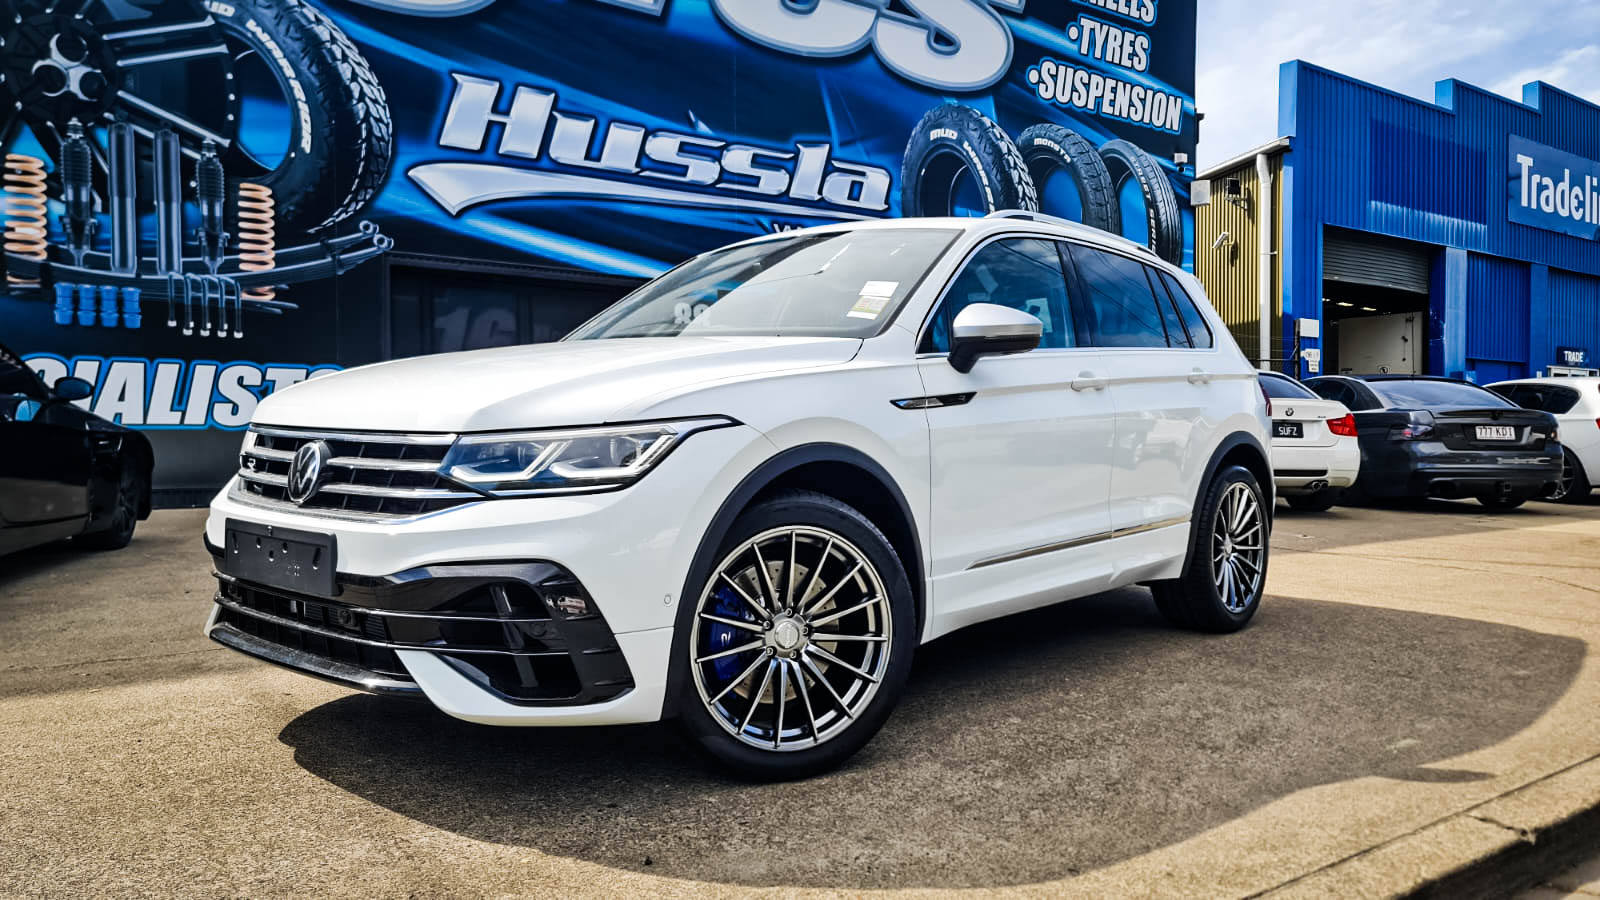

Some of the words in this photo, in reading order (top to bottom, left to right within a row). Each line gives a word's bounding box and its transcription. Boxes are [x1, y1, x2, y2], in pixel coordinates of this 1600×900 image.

[1080, 17, 1149, 71] TYRES
[1038, 61, 1182, 131] SUSPENSION
[439, 73, 892, 211] Hussla
[930, 128, 958, 141] MUD
[1516, 153, 1600, 225] Tradeli
[1563, 350, 1584, 363] TRADE
